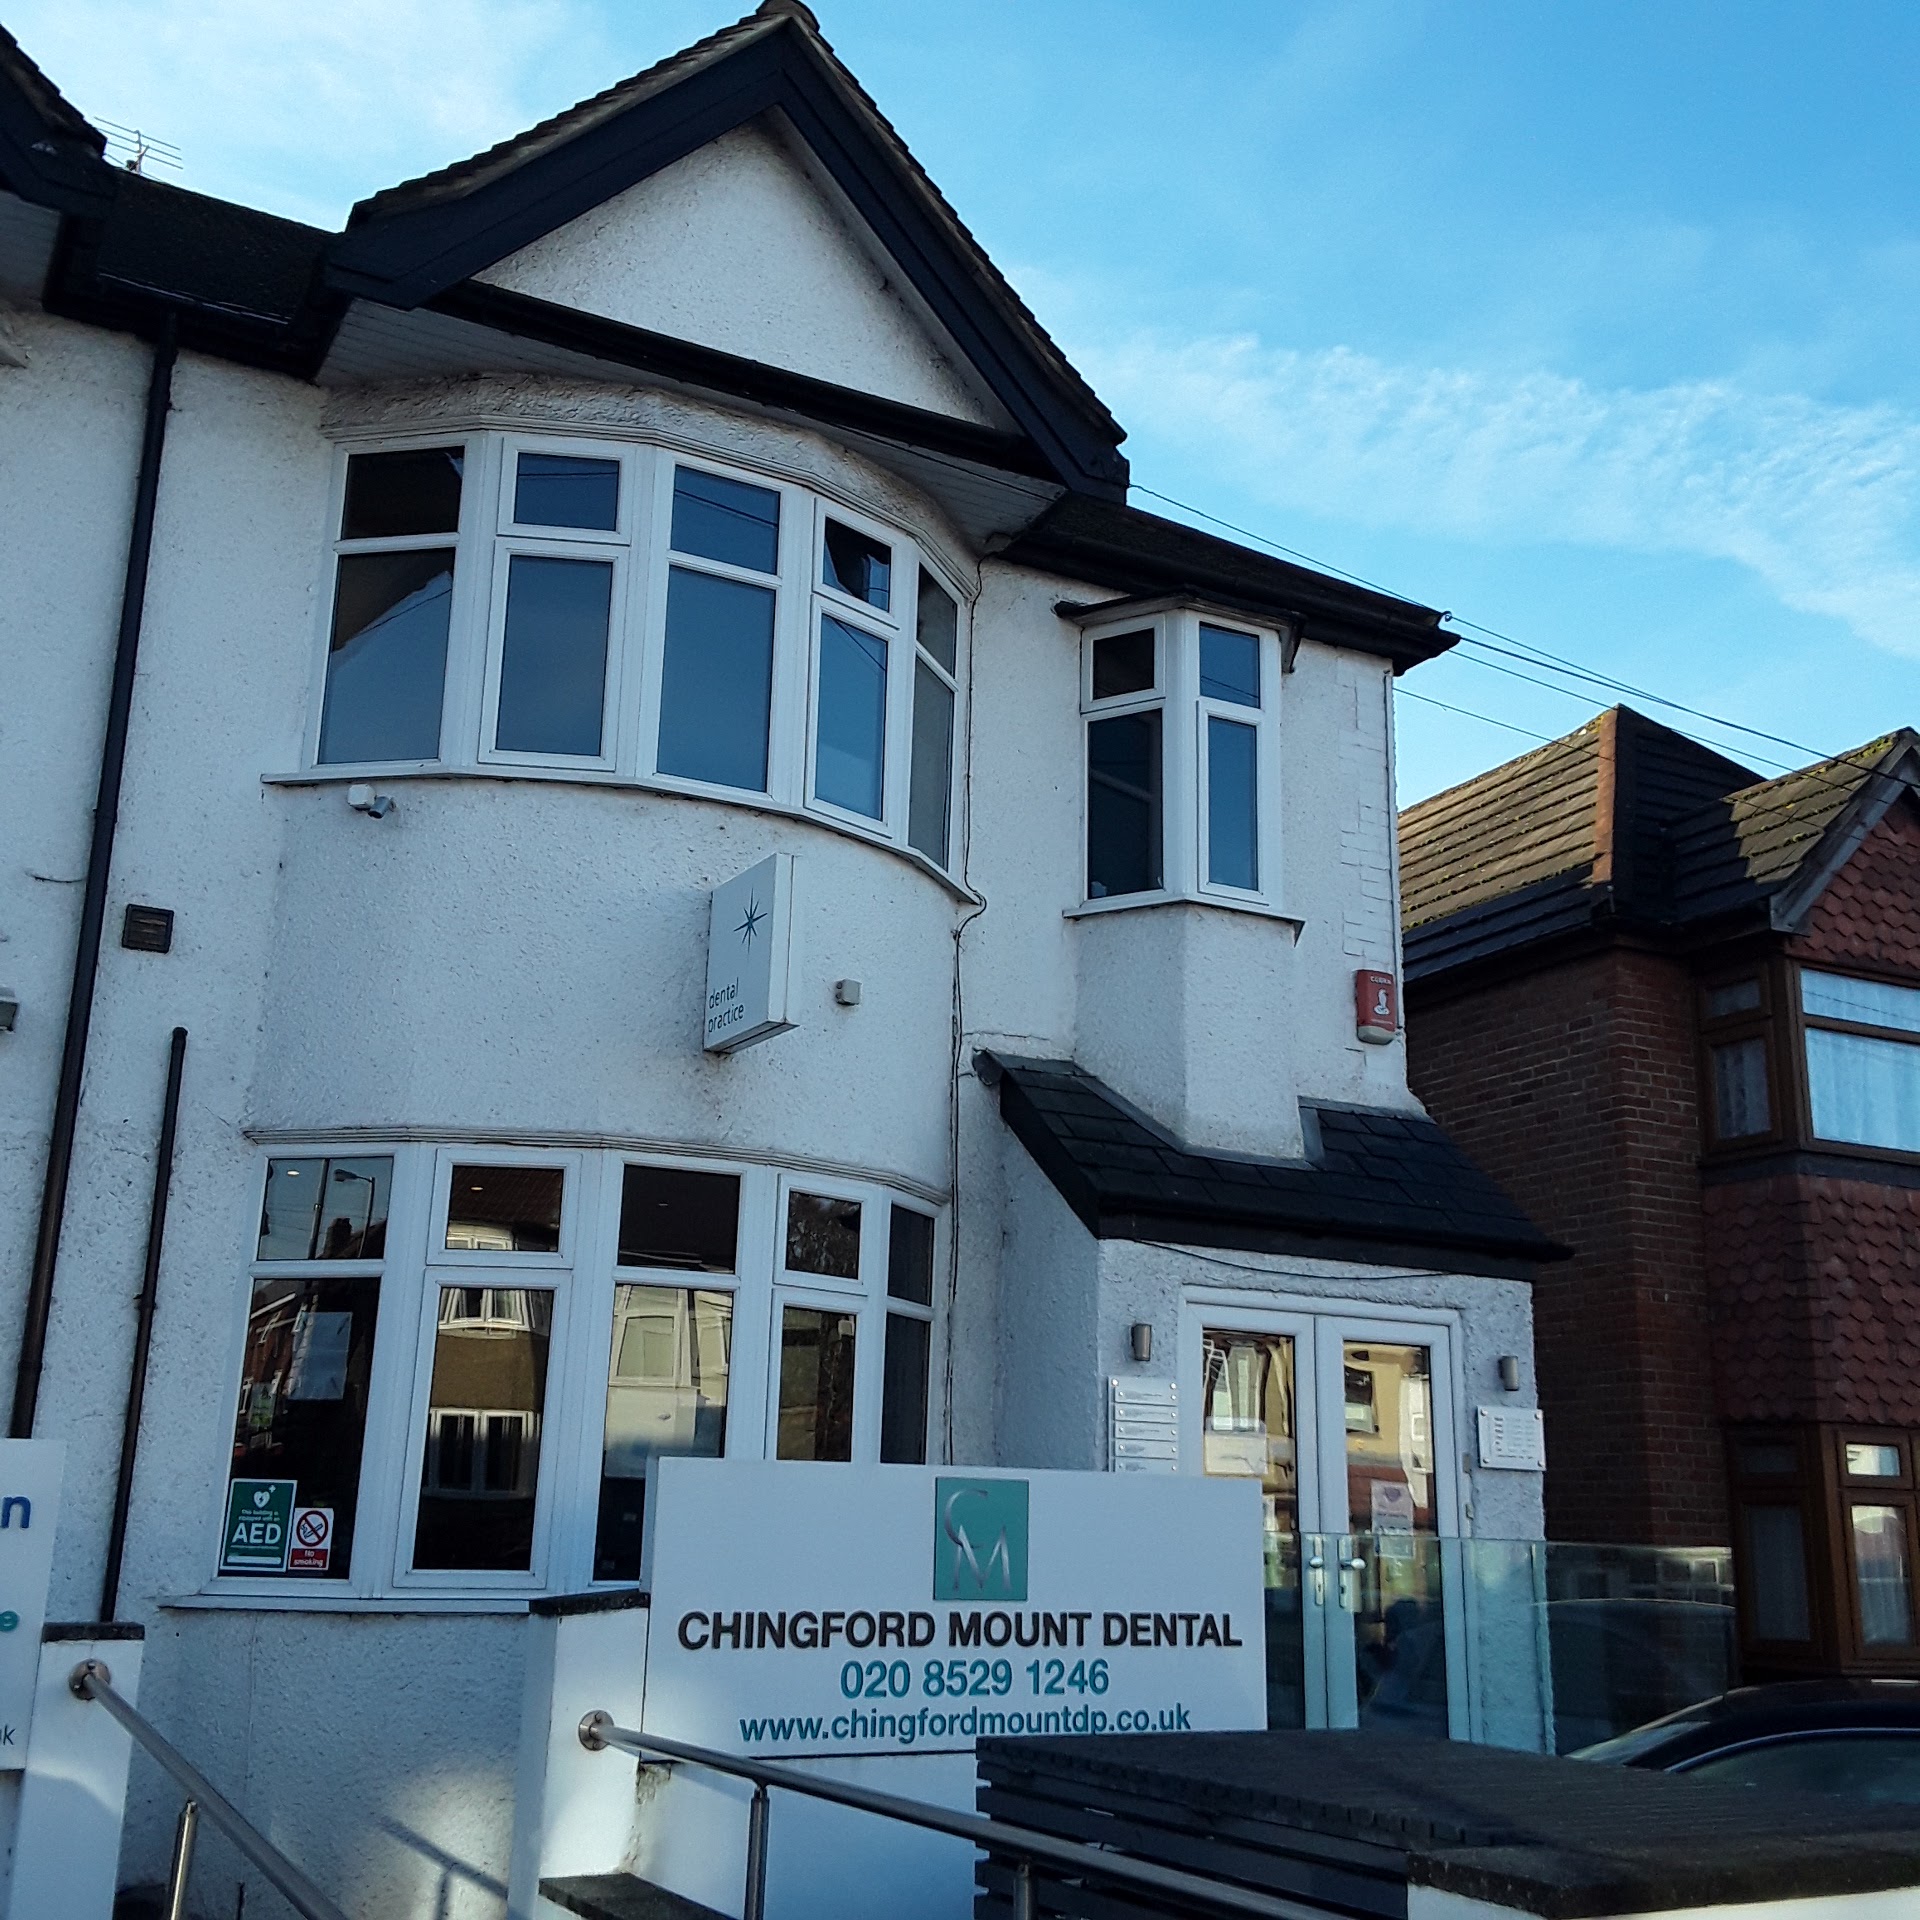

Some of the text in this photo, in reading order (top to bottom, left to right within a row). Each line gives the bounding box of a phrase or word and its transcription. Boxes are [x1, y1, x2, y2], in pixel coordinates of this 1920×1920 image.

[709, 976, 739, 1010] dental
[708, 1003, 744, 1036] practice
[231, 1522, 282, 1545] AED
[293, 1558, 324, 1568] smoking
[304, 1549, 315, 1557] No
[677, 1611, 1243, 1650] CHINGFORD MOUNT DENTAL
[840, 1658, 1110, 1699] 020 8529 1246
[739, 1702, 1192, 1744] www.chingfordmountdp.co.uk
